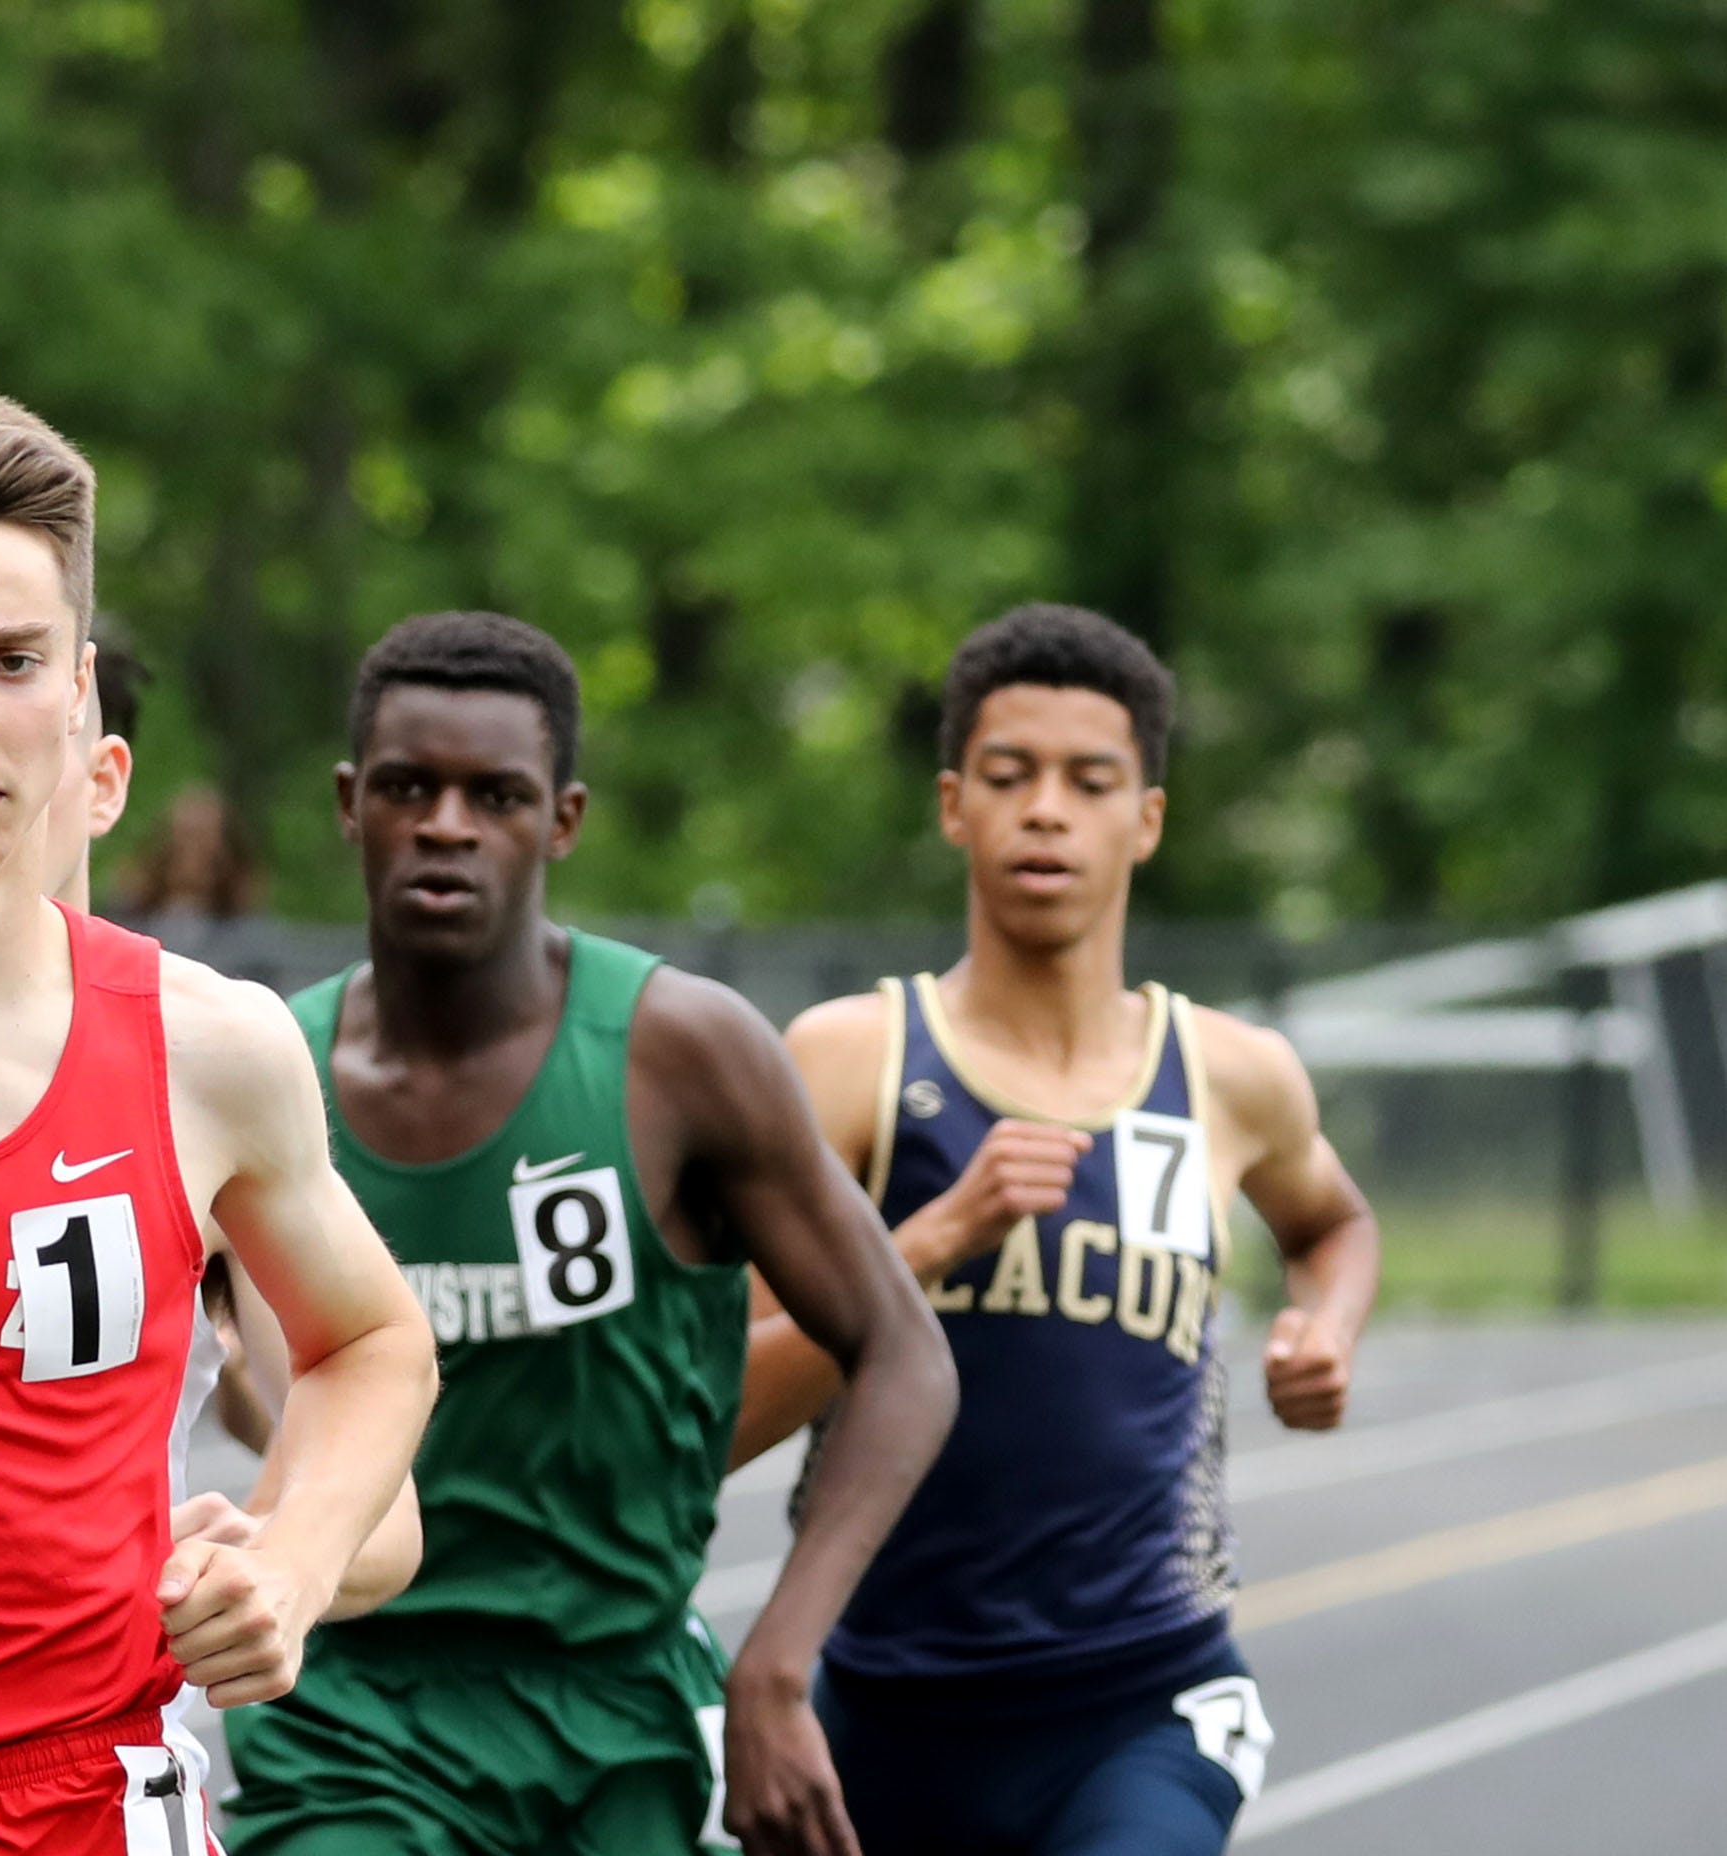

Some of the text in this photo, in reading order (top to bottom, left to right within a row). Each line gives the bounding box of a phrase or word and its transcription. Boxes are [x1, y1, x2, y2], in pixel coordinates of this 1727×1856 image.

[1131, 1126, 1187, 1234] 7
[36, 1214, 101, 1366] 1
[534, 1188, 613, 1307] 8
